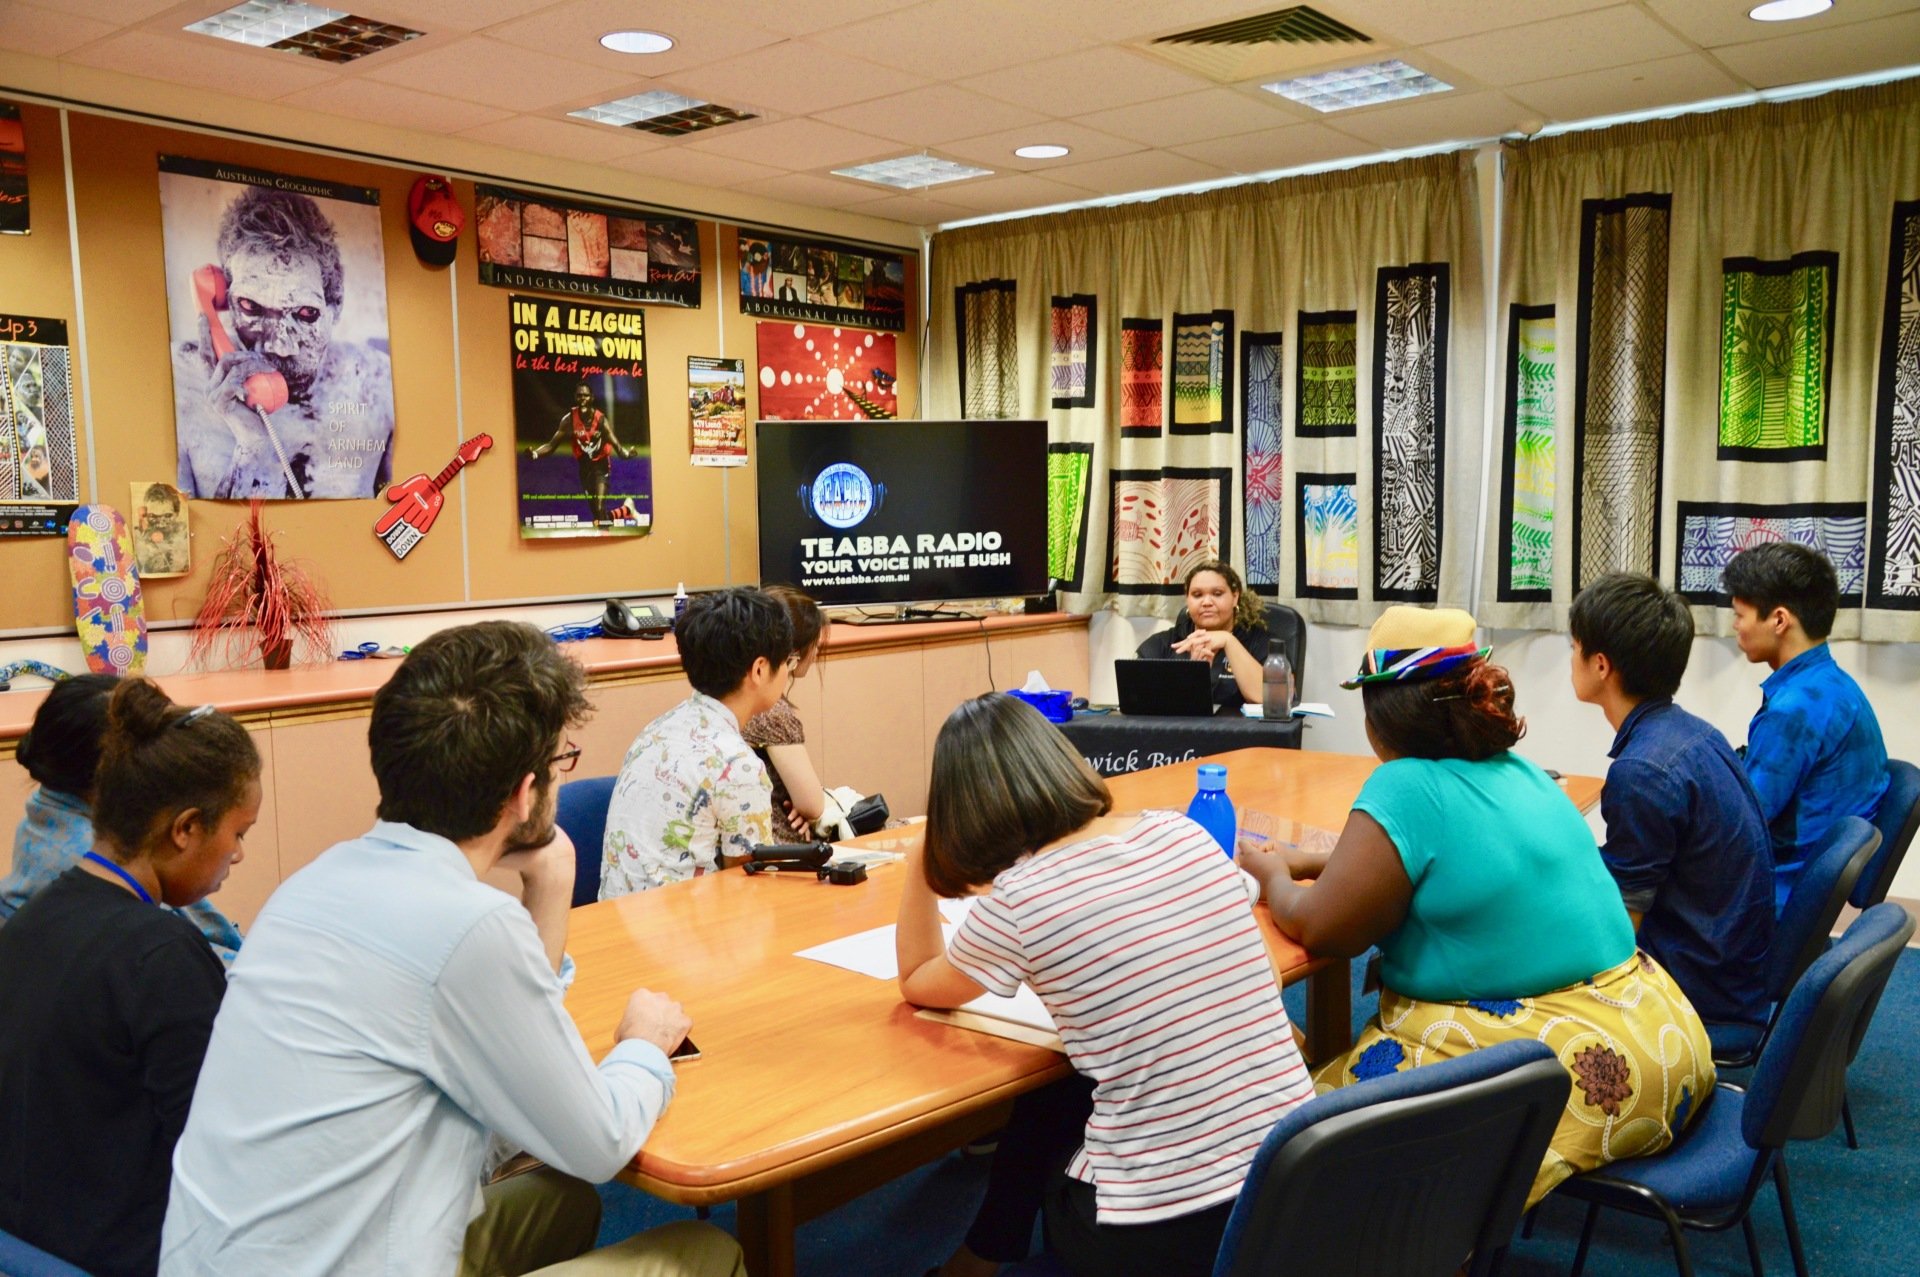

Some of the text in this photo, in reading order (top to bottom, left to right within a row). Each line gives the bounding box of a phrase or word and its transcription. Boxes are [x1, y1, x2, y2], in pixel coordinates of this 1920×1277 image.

[496, 271, 684, 305] INDIGENOUS AUSTRALIA
[513, 302, 643, 336] IN A LEAGUE
[745, 301, 901, 329] ABORIGINAL AUSTRALIA
[27, 320, 38, 337] 3
[514, 329, 643, 361] OF THEIR OWN
[516, 353, 643, 379] be the best you can be
[329, 401, 368, 416] SPIRIT
[329, 420, 346, 433] OF
[328, 439, 386, 451] ARNHEM
[328, 456, 363, 470] LAND
[396, 531, 419, 556] DOWN
[801, 532, 1002, 558] TEABBA RADIO
[801, 552, 1011, 575] YOUR VOICE IN THE BUSH
[801, 574, 910, 587] www.teabba.com.au
